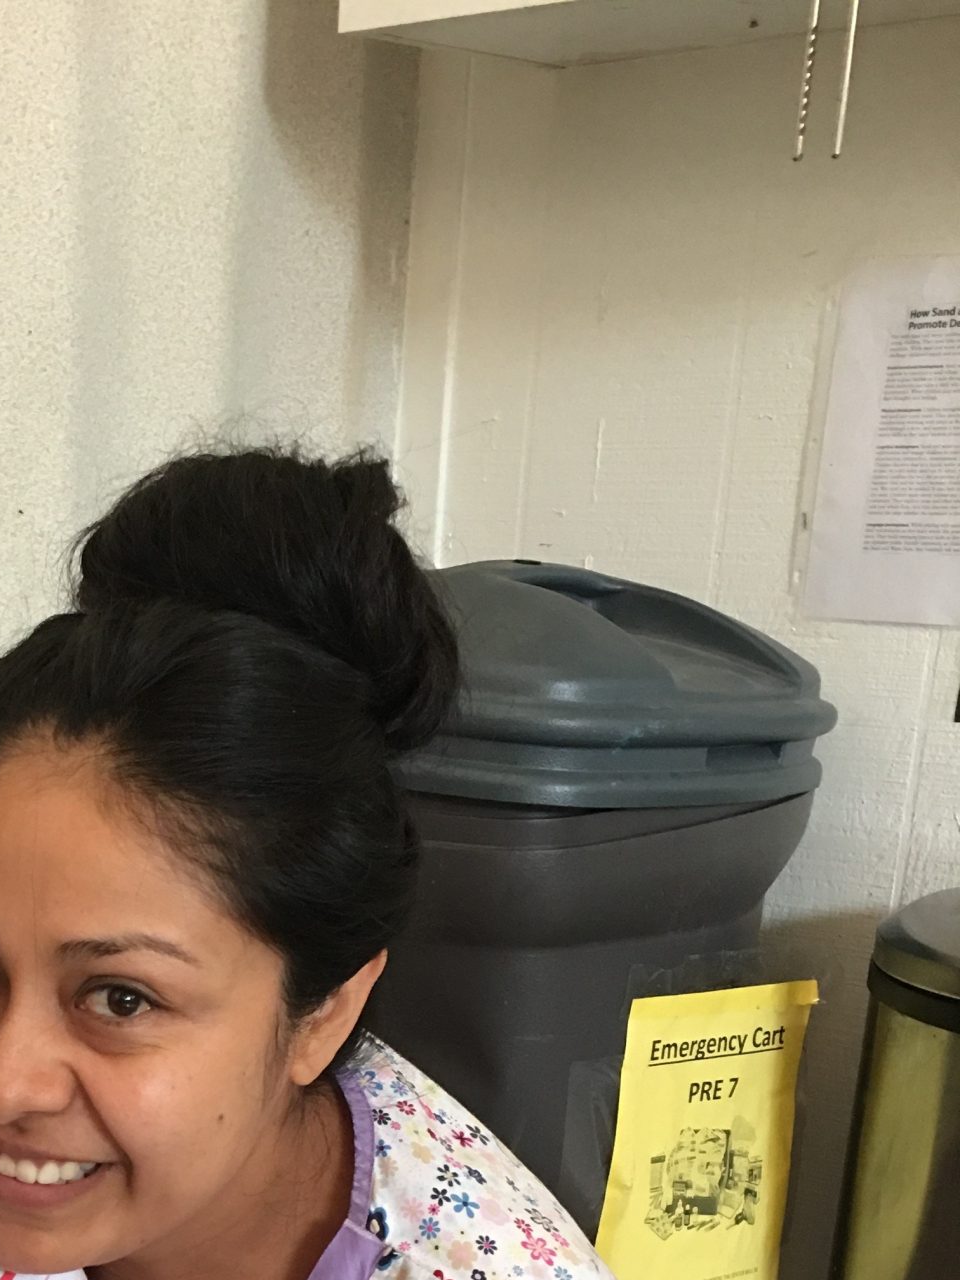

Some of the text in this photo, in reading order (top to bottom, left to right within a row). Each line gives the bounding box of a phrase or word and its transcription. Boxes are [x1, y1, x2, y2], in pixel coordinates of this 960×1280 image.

[910, 306, 956, 319] How Sand
[908, 320, 947, 331] Promote
[650, 1025, 785, 1060] Emergency Cart
[688, 1077, 739, 1103] PRE 7
